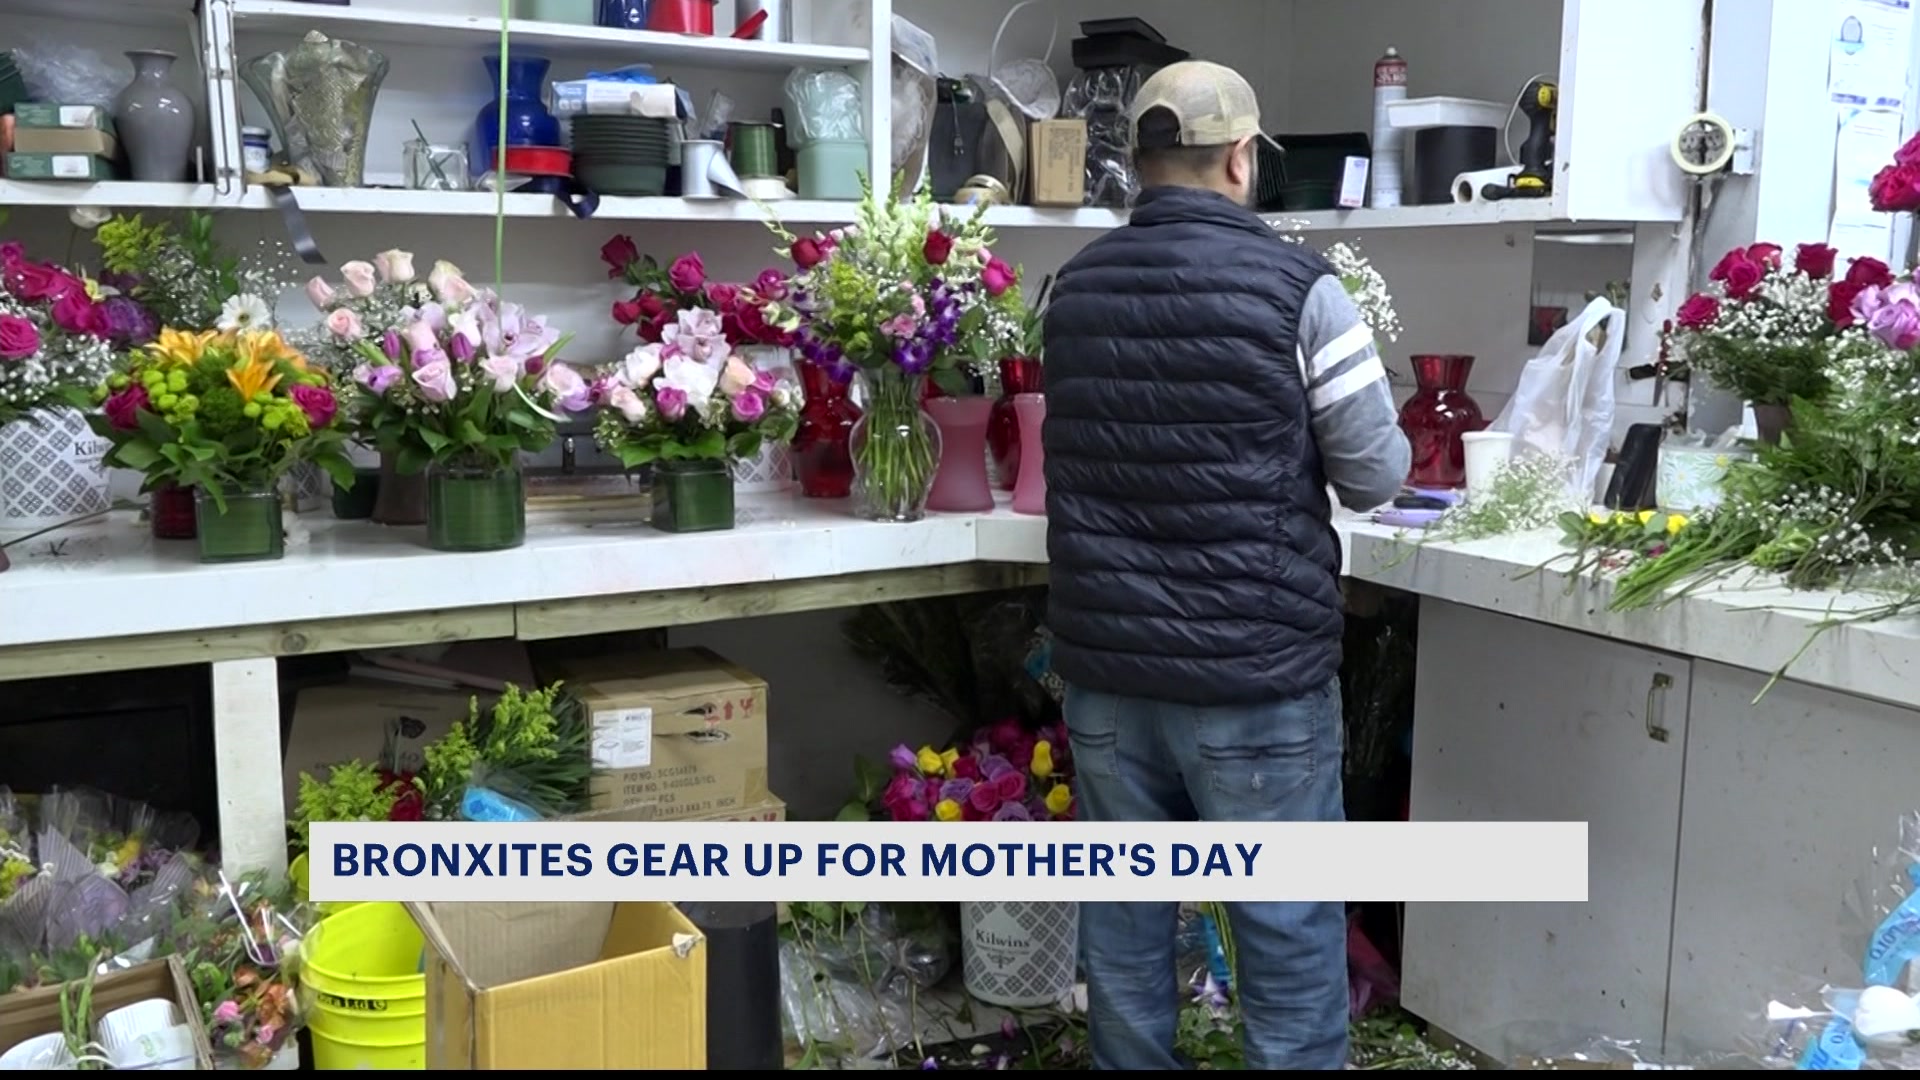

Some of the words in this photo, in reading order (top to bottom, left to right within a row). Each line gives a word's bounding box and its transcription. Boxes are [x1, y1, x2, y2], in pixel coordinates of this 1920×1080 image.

[623, 784, 643, 796] ITEM
[658, 793, 675, 804] PCS
[975, 929, 1031, 948] Kilwins
